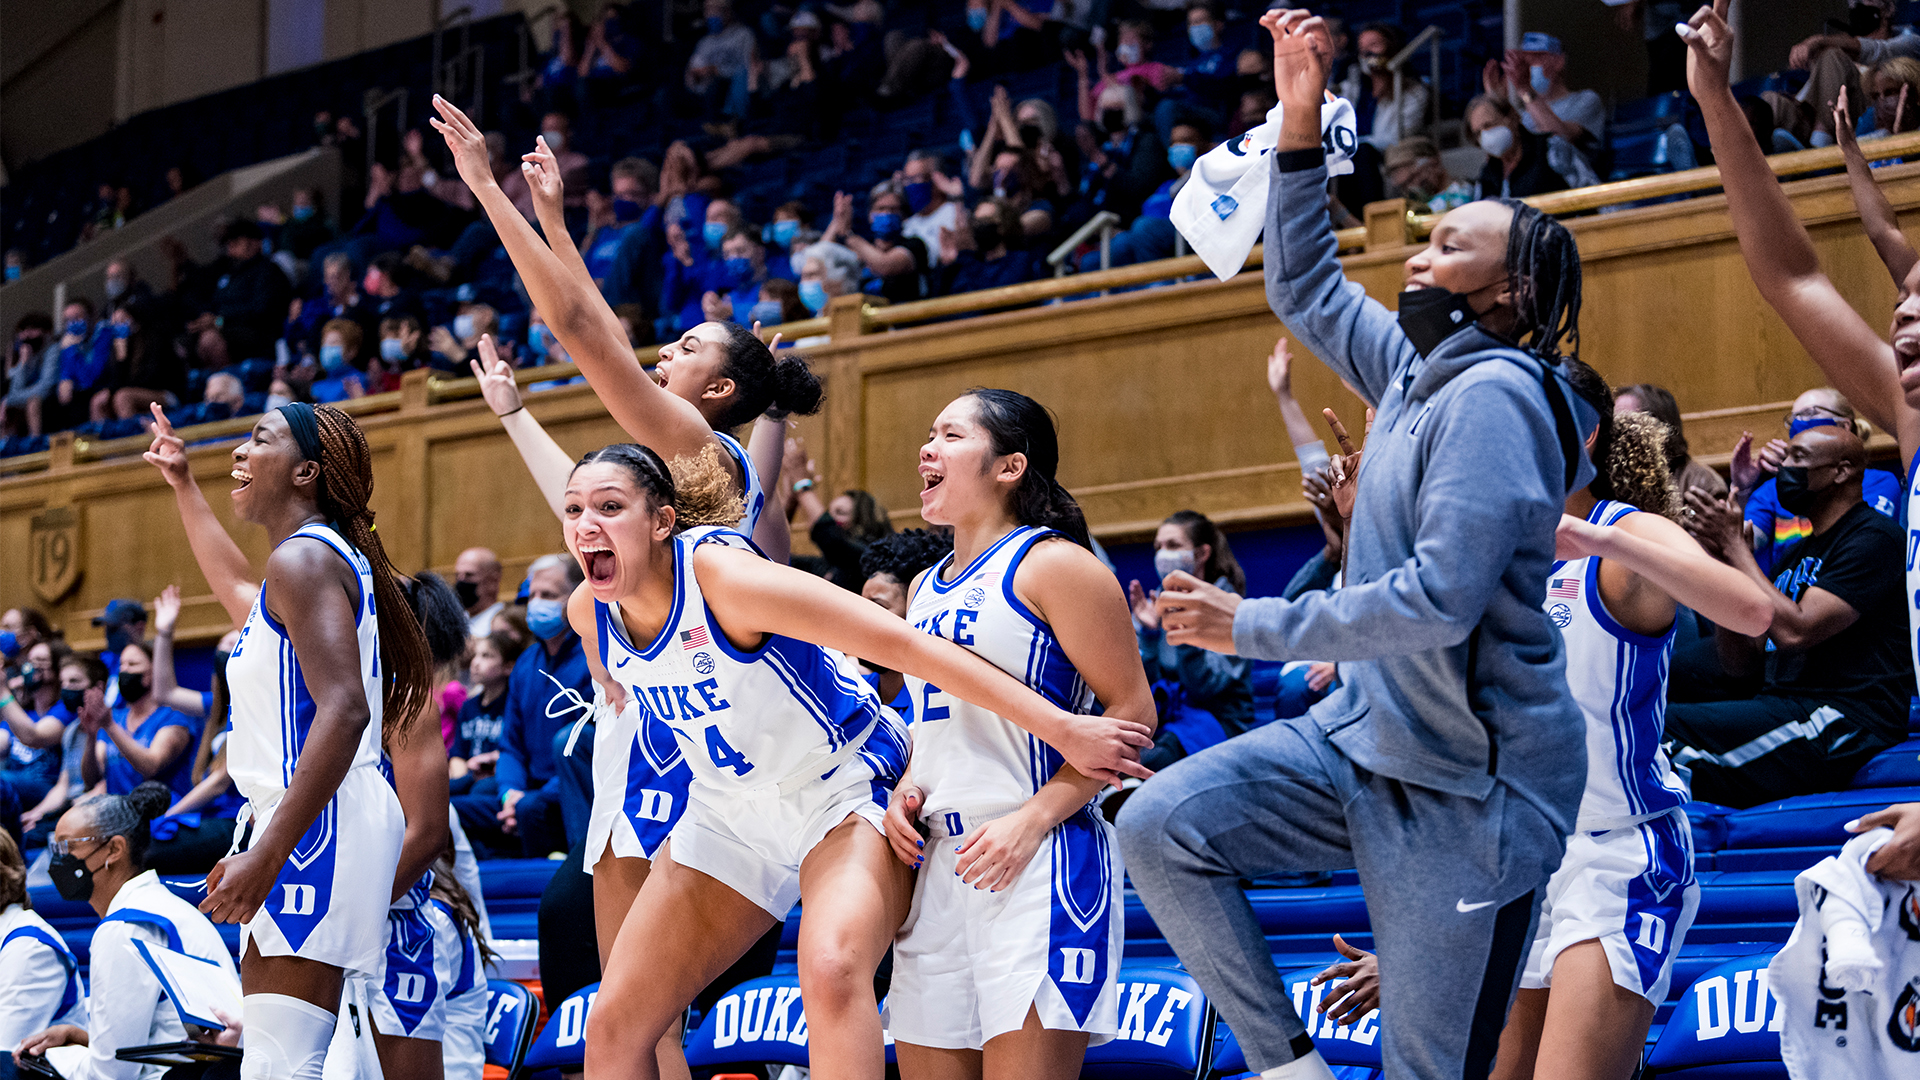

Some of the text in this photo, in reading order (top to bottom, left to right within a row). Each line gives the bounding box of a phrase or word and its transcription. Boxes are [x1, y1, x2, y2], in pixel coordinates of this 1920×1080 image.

[38, 532, 70, 585] 19
[914, 609, 979, 646] KE
[632, 677, 731, 720] DUKE
[672, 724, 755, 777] 4
[634, 788, 674, 823] D
[944, 811, 965, 837] D
[279, 883, 316, 916] D
[1634, 911, 1666, 954] D
[1059, 947, 1096, 984] D
[394, 972, 426, 1003] D
[1694, 968, 1786, 1041] DU
[1116, 982, 1194, 1047] KE
